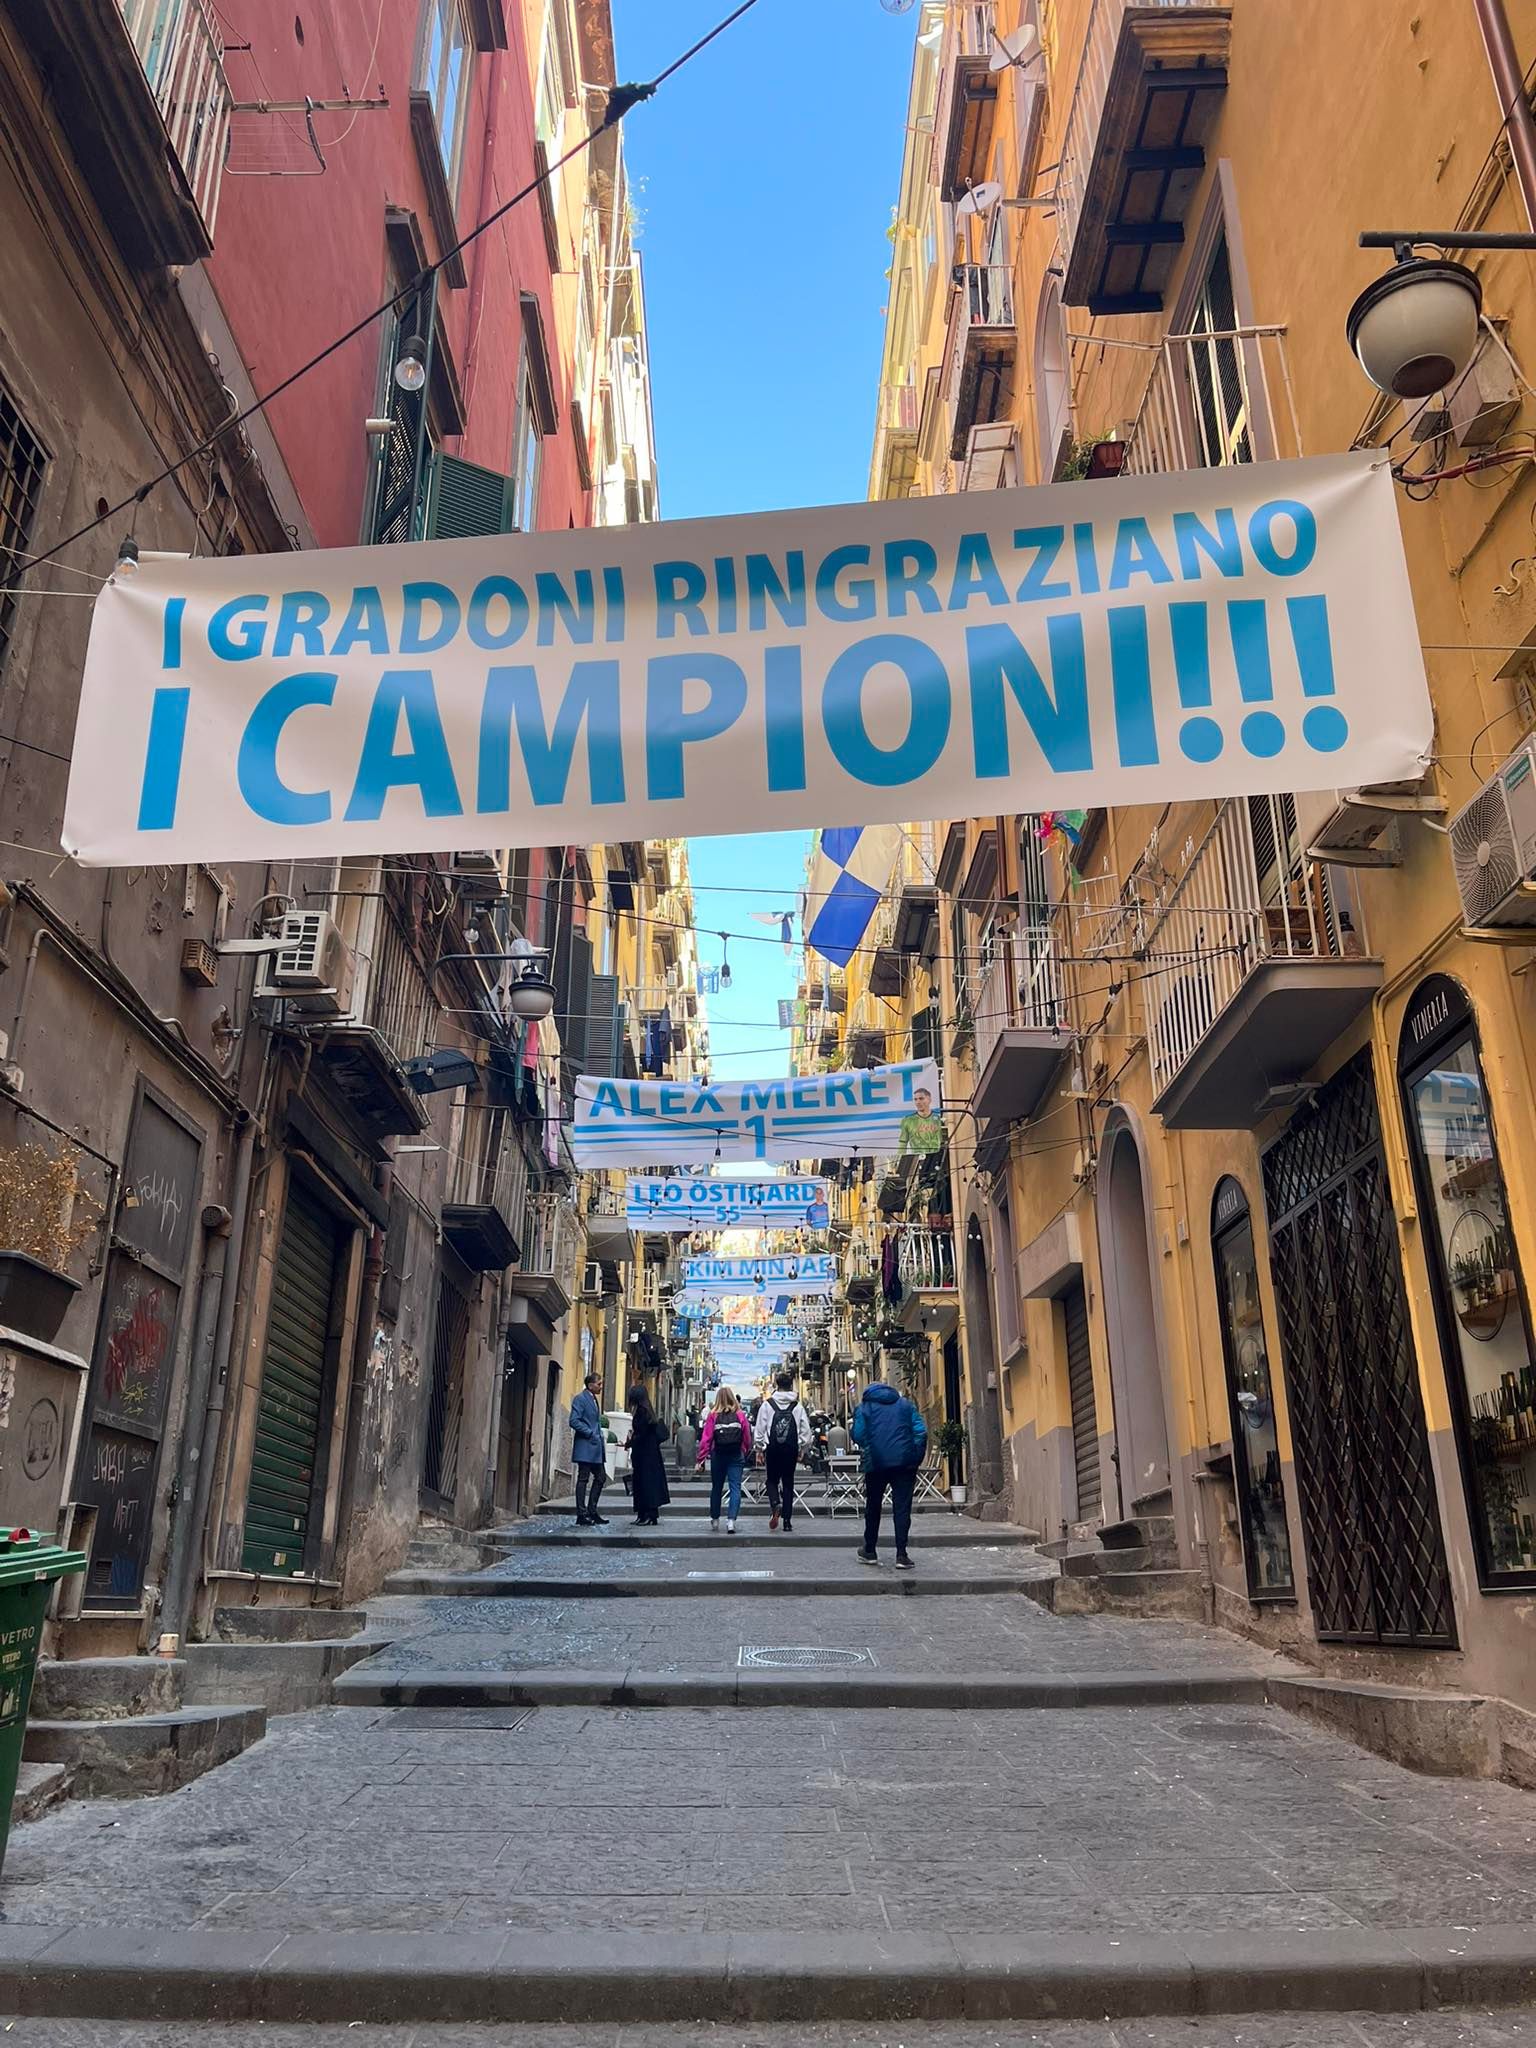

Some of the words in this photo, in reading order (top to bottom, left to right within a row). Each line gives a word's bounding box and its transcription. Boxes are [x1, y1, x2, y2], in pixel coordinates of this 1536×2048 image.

[162, 597, 186, 669] I
[207, 566, 626, 662] GRADONI
[653, 499, 1317, 640] RINGRAZIANO
[137, 687, 191, 831] I
[237, 594, 1350, 826] CAMPIONI!!!
[1411, 991, 1449, 1044] VINERIA
[589, 1080, 725, 1118] ALEX
[740, 1065, 924, 1112] MERET
[744, 1114, 767, 1159] 1
[634, 1183, 683, 1203] LEO
[715, 1206, 741, 1222] 55
[689, 1260, 732, 1277] KIM
[739, 1259, 784, 1276] MIN
[791, 1255, 831, 1274] JAE
[756, 1281, 767, 1293] 3
[1, 1626, 35, 1645] VETRO
